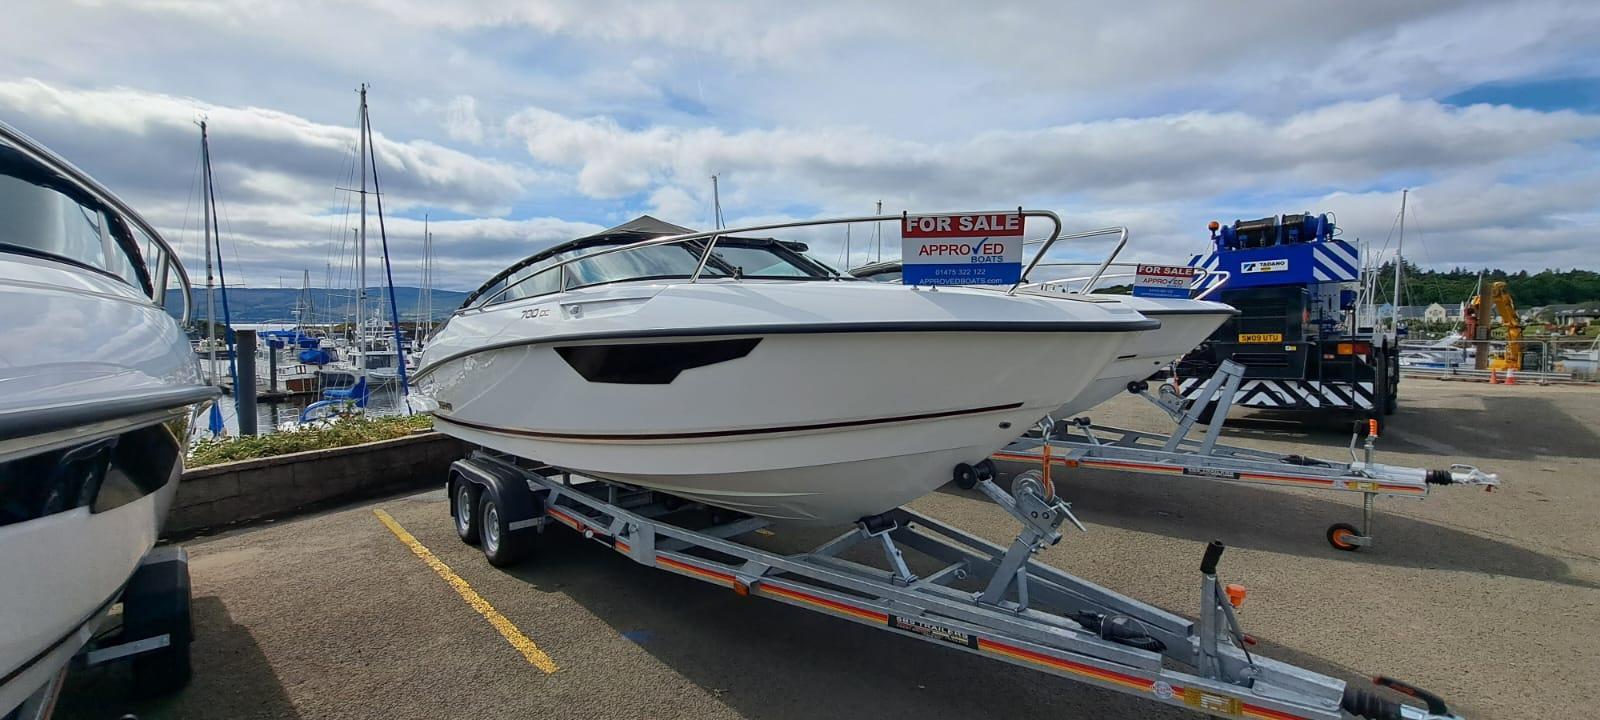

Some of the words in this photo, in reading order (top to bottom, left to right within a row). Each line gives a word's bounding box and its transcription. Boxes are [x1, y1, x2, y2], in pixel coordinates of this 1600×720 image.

[906, 217, 952, 232] FOR
[959, 215, 1020, 231] SALE
[971, 255, 1004, 263] BOATS
[959, 268, 972, 276] 322
[974, 268, 986, 276] 122
[1139, 266, 1161, 274] FOR
[919, 277, 1003, 285] APPROVEDBOATS.com
[521, 308, 539, 320] 700
